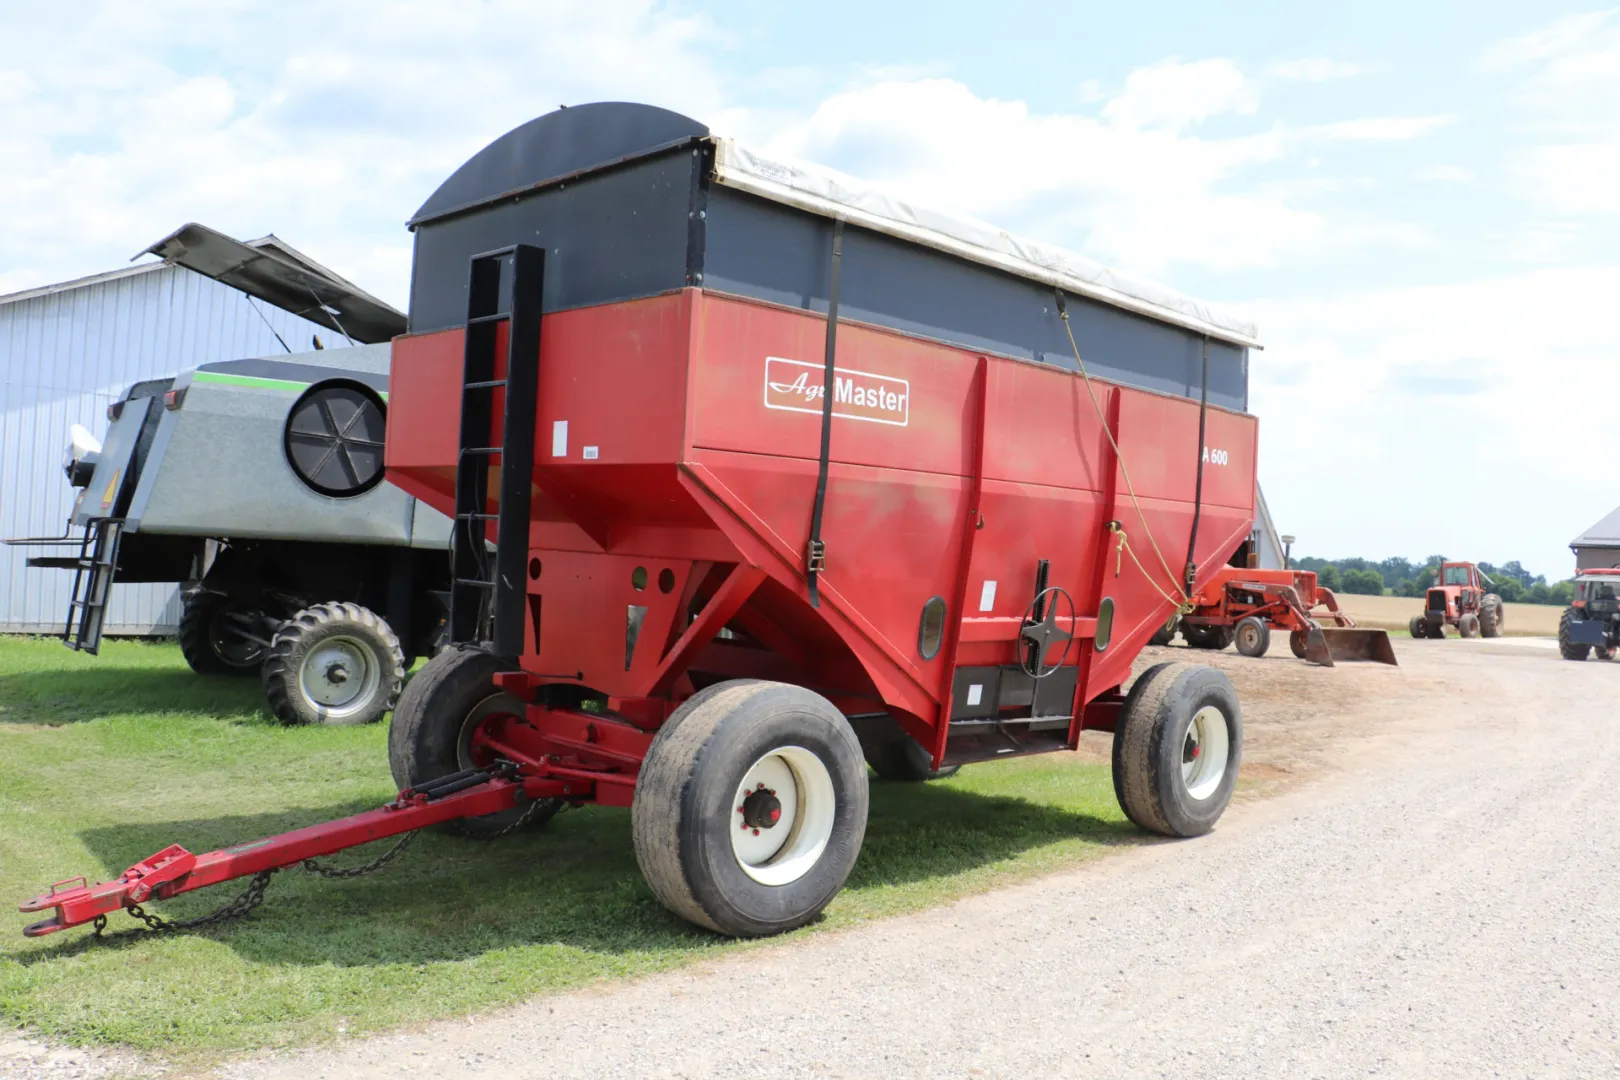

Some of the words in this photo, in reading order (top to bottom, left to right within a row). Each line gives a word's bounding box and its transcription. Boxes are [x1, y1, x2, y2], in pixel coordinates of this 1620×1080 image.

[769, 372, 826, 402] Agr
[834, 377, 906, 412] Master
[1211, 448, 1228, 466] 600
